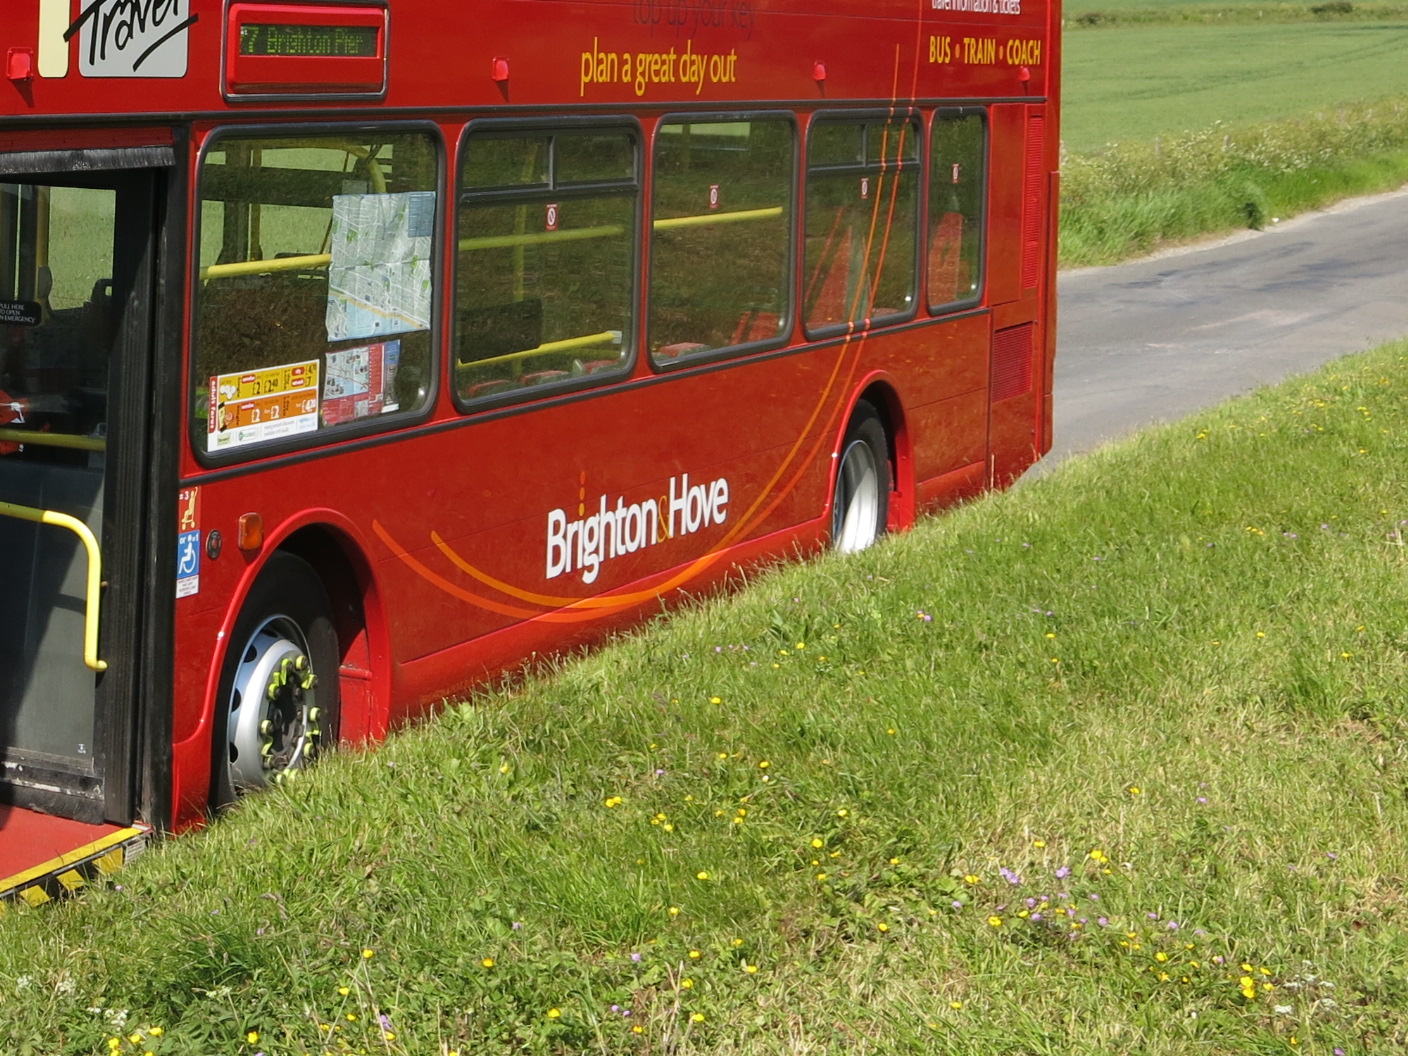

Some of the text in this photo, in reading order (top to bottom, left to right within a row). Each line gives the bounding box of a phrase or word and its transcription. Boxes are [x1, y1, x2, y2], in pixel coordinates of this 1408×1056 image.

[929, 35, 1041, 65] BUS TRAIN COACH
[580, 36, 737, 97] plan a great day out
[5, 315, 35, 324] EMERGENCY
